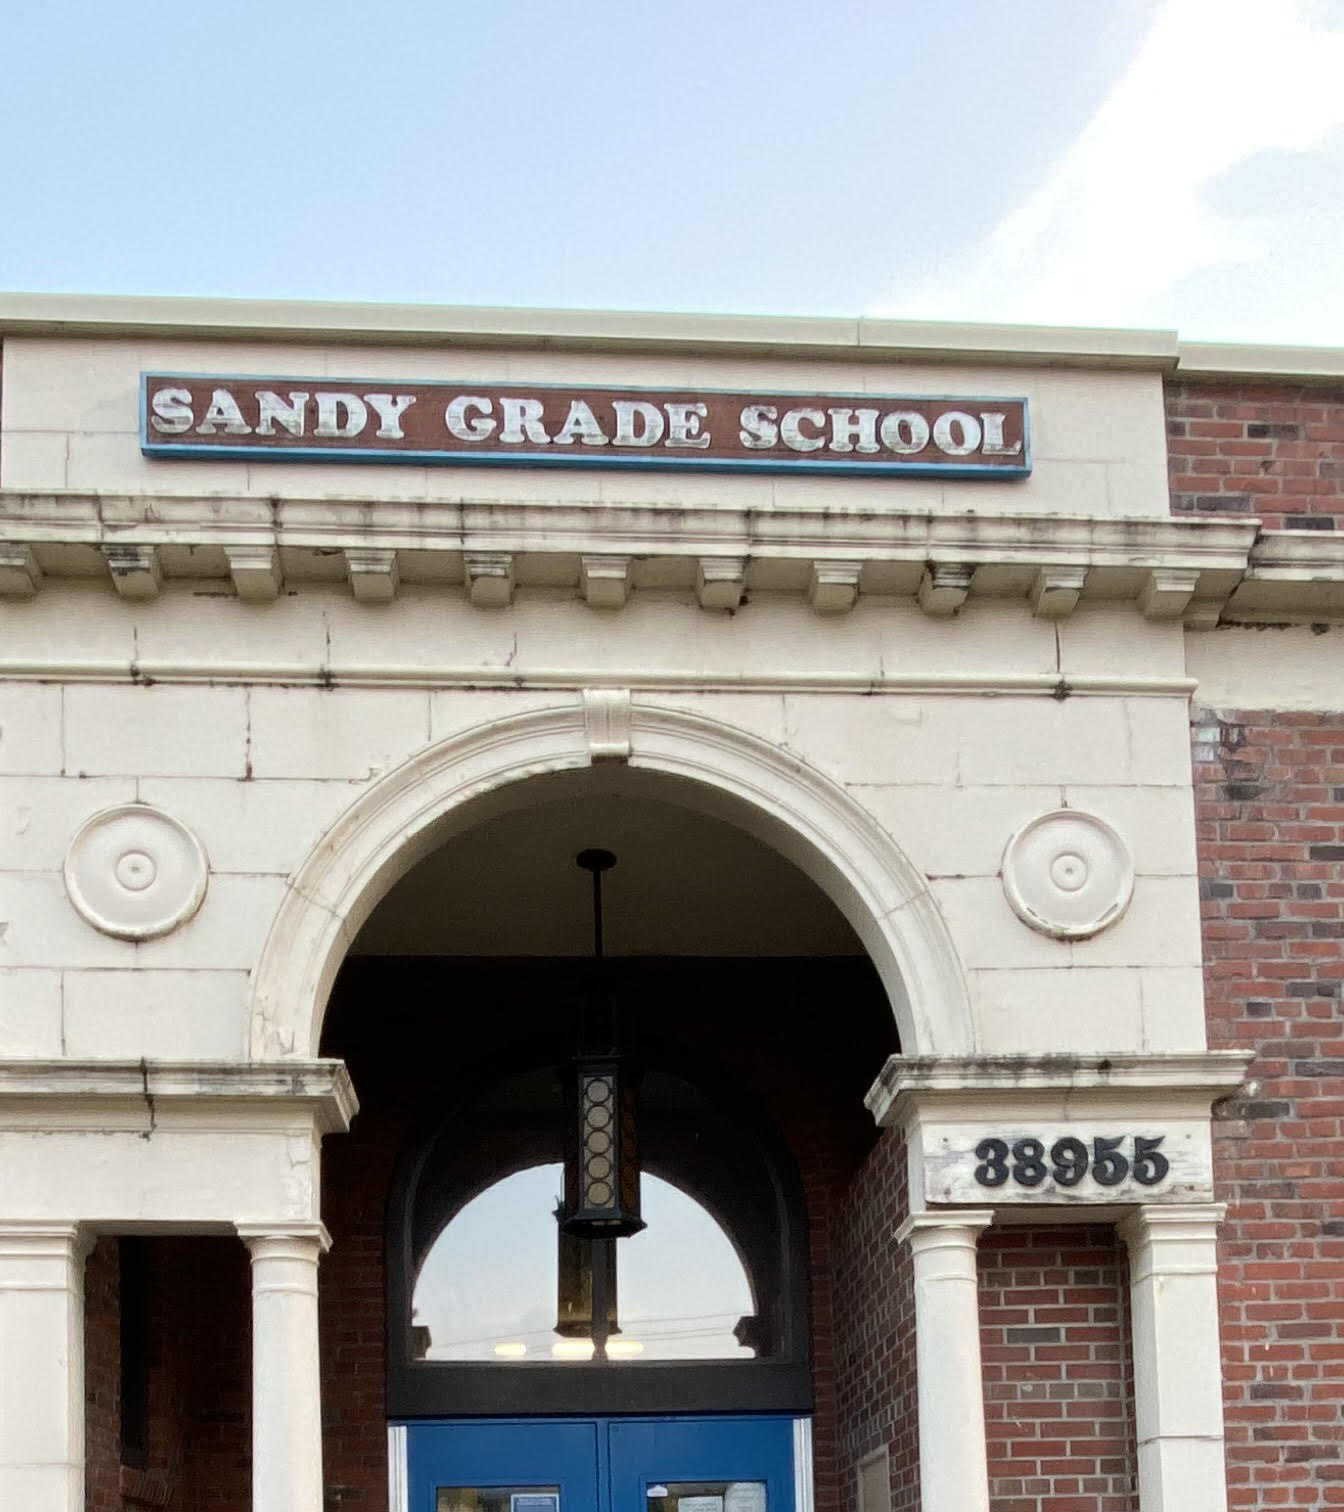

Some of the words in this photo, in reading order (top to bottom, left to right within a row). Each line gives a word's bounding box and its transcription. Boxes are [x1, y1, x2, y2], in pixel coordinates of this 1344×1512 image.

[150, 388, 417, 440] SANDY
[444, 396, 711, 450] GRADE
[738, 404, 1022, 457] SCHOOL
[973, 1135, 1170, 1187] 38955
